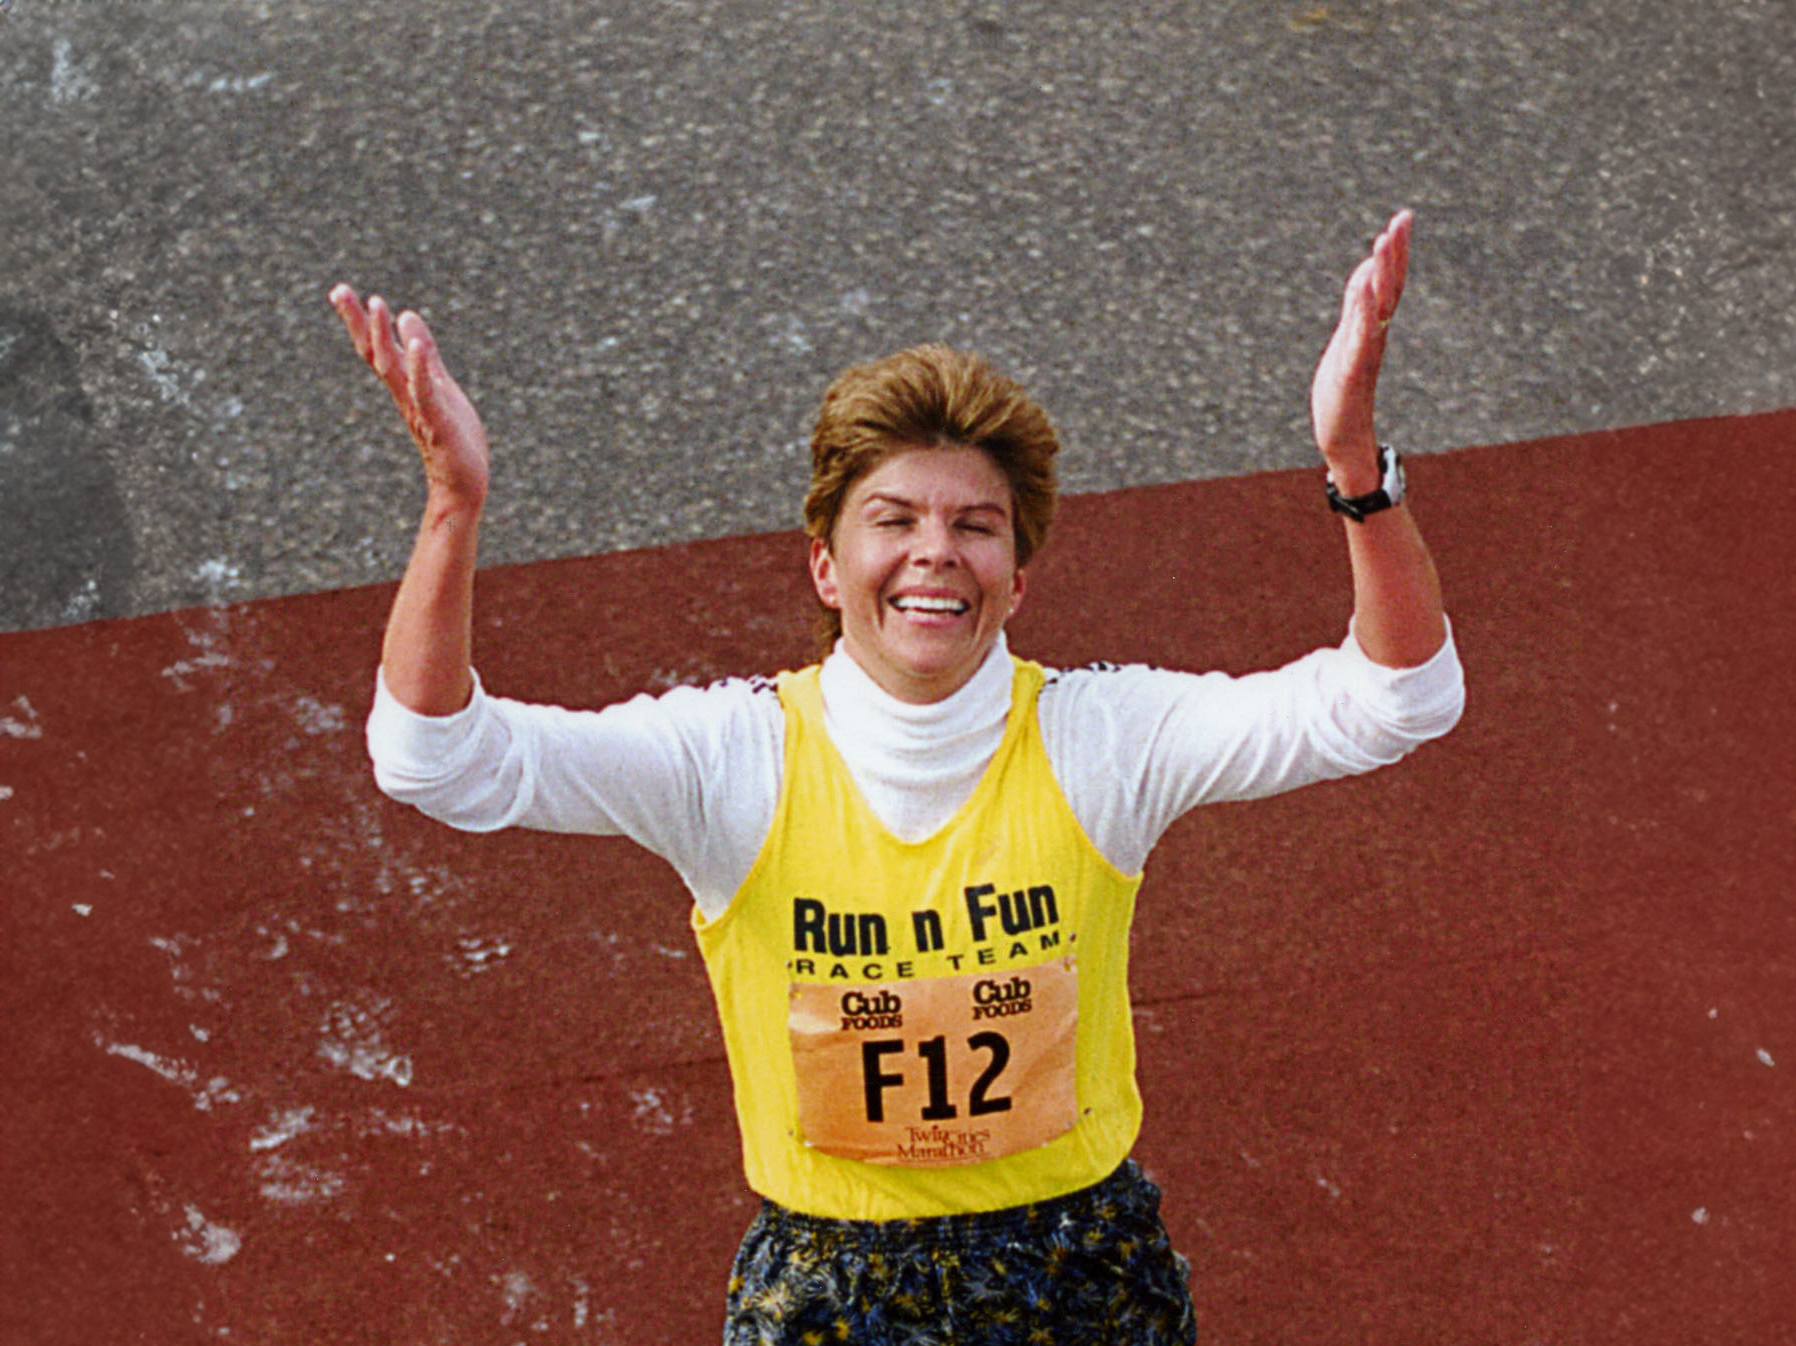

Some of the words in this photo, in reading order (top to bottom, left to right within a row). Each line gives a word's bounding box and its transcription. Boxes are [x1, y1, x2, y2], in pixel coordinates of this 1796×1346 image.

[793, 897, 889, 957] Run
[911, 908, 945, 953] n
[964, 883, 1060, 942] Fun
[795, 959, 914, 980] RACE
[947, 931, 1060, 971] TEAM
[841, 991, 902, 1017] Cub
[972, 976, 1032, 1005] Cub
[841, 1014, 903, 1031] FOODS
[972, 998, 1033, 1020] FOODS
[861, 1031, 1012, 1123] F12
